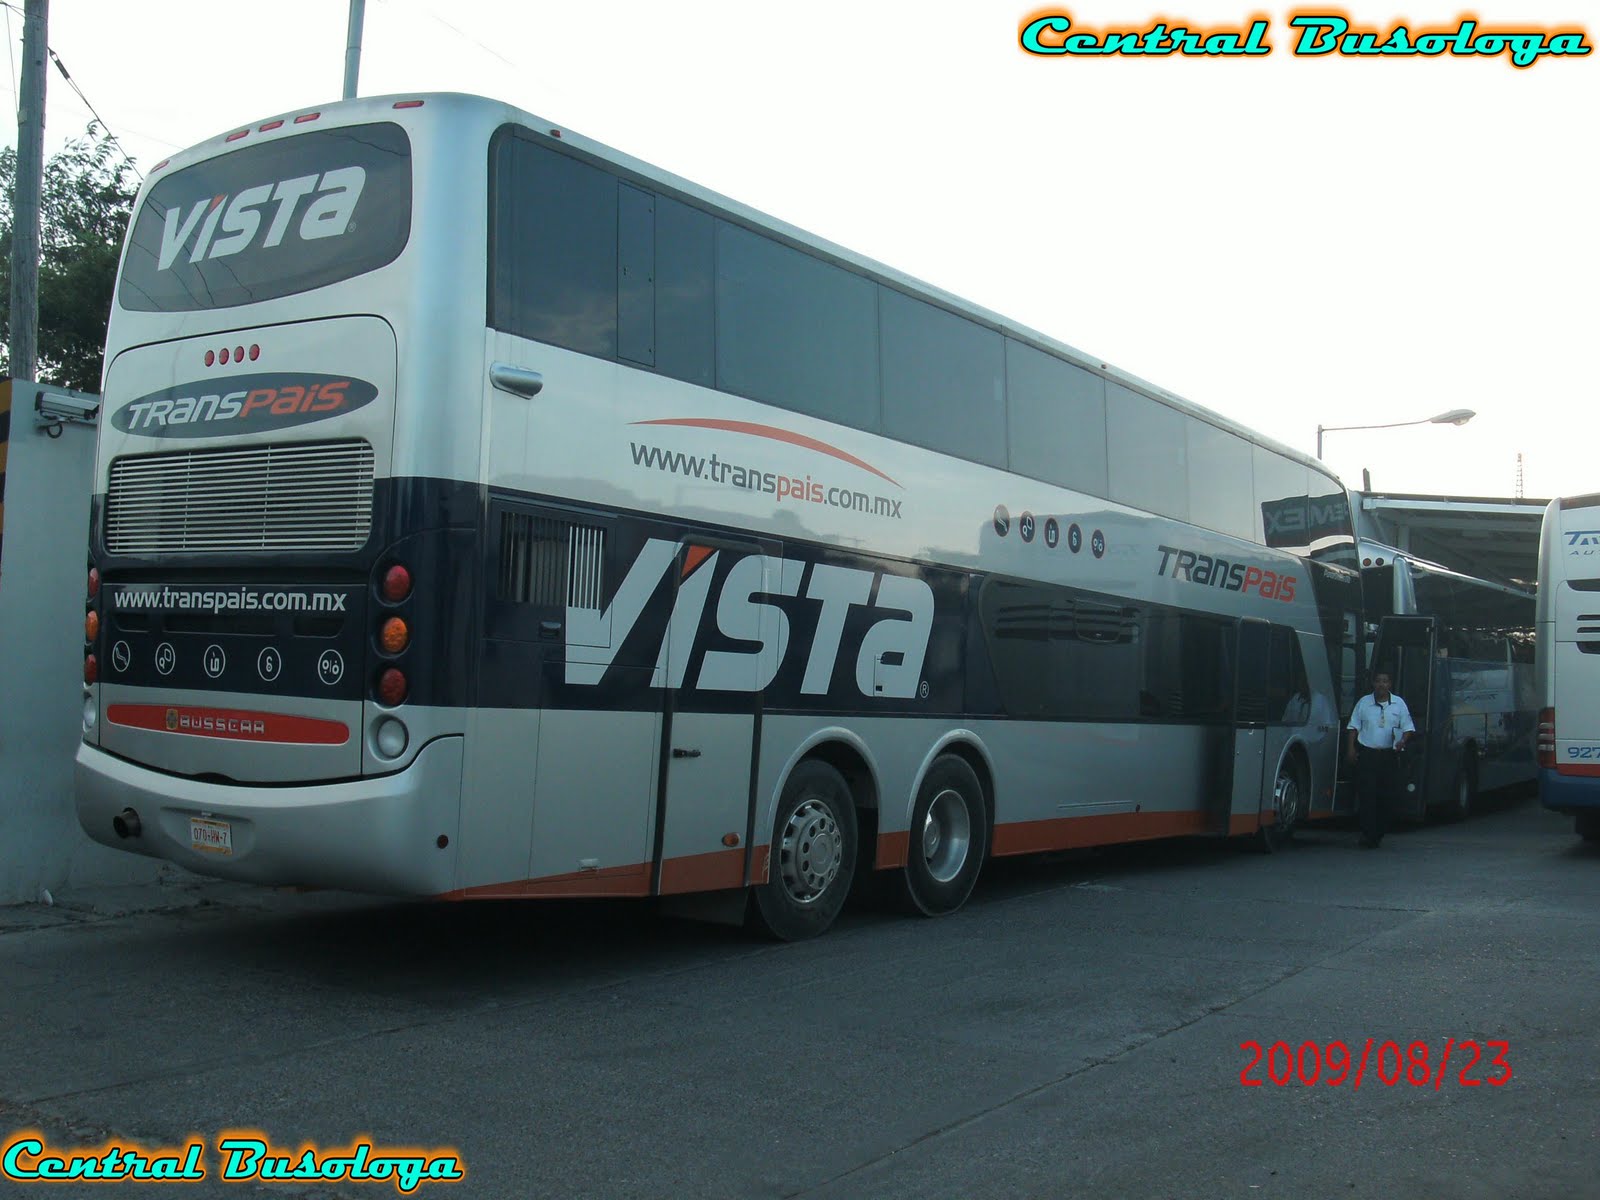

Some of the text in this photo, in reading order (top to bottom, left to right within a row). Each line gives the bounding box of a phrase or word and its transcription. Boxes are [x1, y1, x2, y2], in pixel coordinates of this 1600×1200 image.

[630, 442, 902, 519] www.transpais.com.mx
[113, 586, 347, 614] www.transpais.com.mx
[180, 714, 265, 734] BUSSCAR
